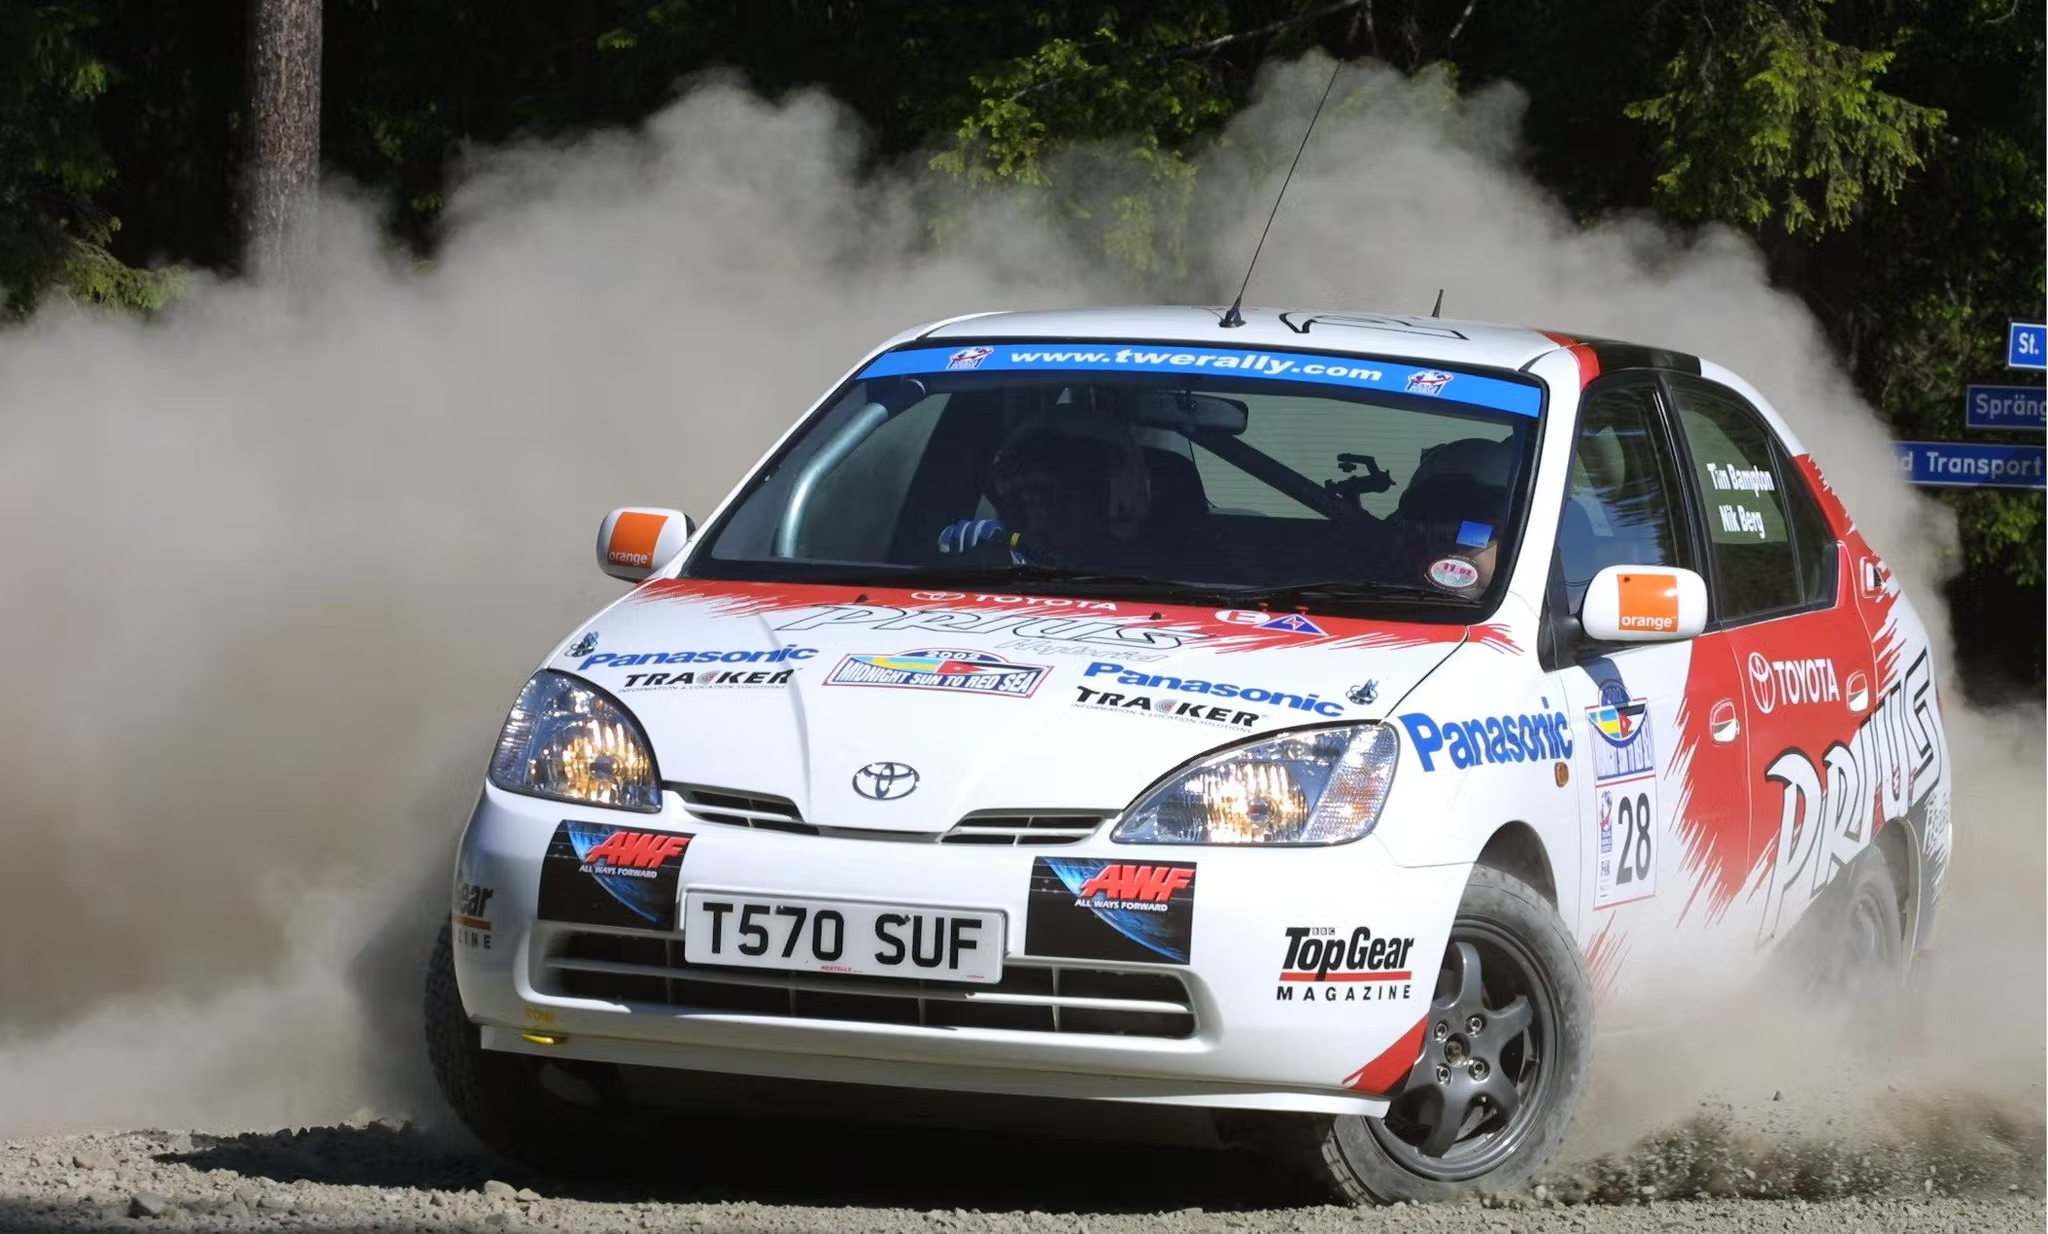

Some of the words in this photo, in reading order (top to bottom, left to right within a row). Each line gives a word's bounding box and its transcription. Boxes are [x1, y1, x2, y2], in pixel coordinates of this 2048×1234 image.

[2018, 332, 2039, 355] St.
[1010, 348, 1383, 382] www.twerally.com
[1706, 463, 1731, 490] Tim
[1726, 463, 1775, 497] Bampton
[1926, 451, 2042, 479] Transport
[1719, 505, 1740, 532] Nik
[1737, 505, 1766, 539] Berg
[608, 551, 648, 565] orange
[976, 594, 1118, 611] TOYOTA
[774, 602, 1211, 650] PRIUS
[1621, 616, 1673, 630] orange
[576, 644, 820, 671] Panasonic
[926, 650, 981, 661] 2002
[835, 659, 911, 684] MIDNIGHT
[909, 673, 943, 686] SUN
[943, 675, 965, 687] TO
[965, 675, 1000, 690] RED
[998, 671, 1037, 693] SEA
[1084, 661, 1345, 718] Panasonic
[1771, 658, 1841, 706] TOYOTA
[1397, 696, 1573, 772] Panasonic
[585, 831, 691, 869] AWF
[1616, 792, 1651, 886] 28
[579, 864, 592, 873] ALL
[594, 867, 616, 875] WAYS
[617, 868, 658, 878] FORWARD
[1080, 864, 1196, 902] AWF
[1074, 899, 1092, 907] ALL
[1093, 900, 1120, 909] WAYS
[1121, 902, 1168, 912] FORWARD
[702, 902, 845, 962] T570
[874, 913, 983, 970] SUF
[1276, 984, 1412, 1001] MAGAZINE
